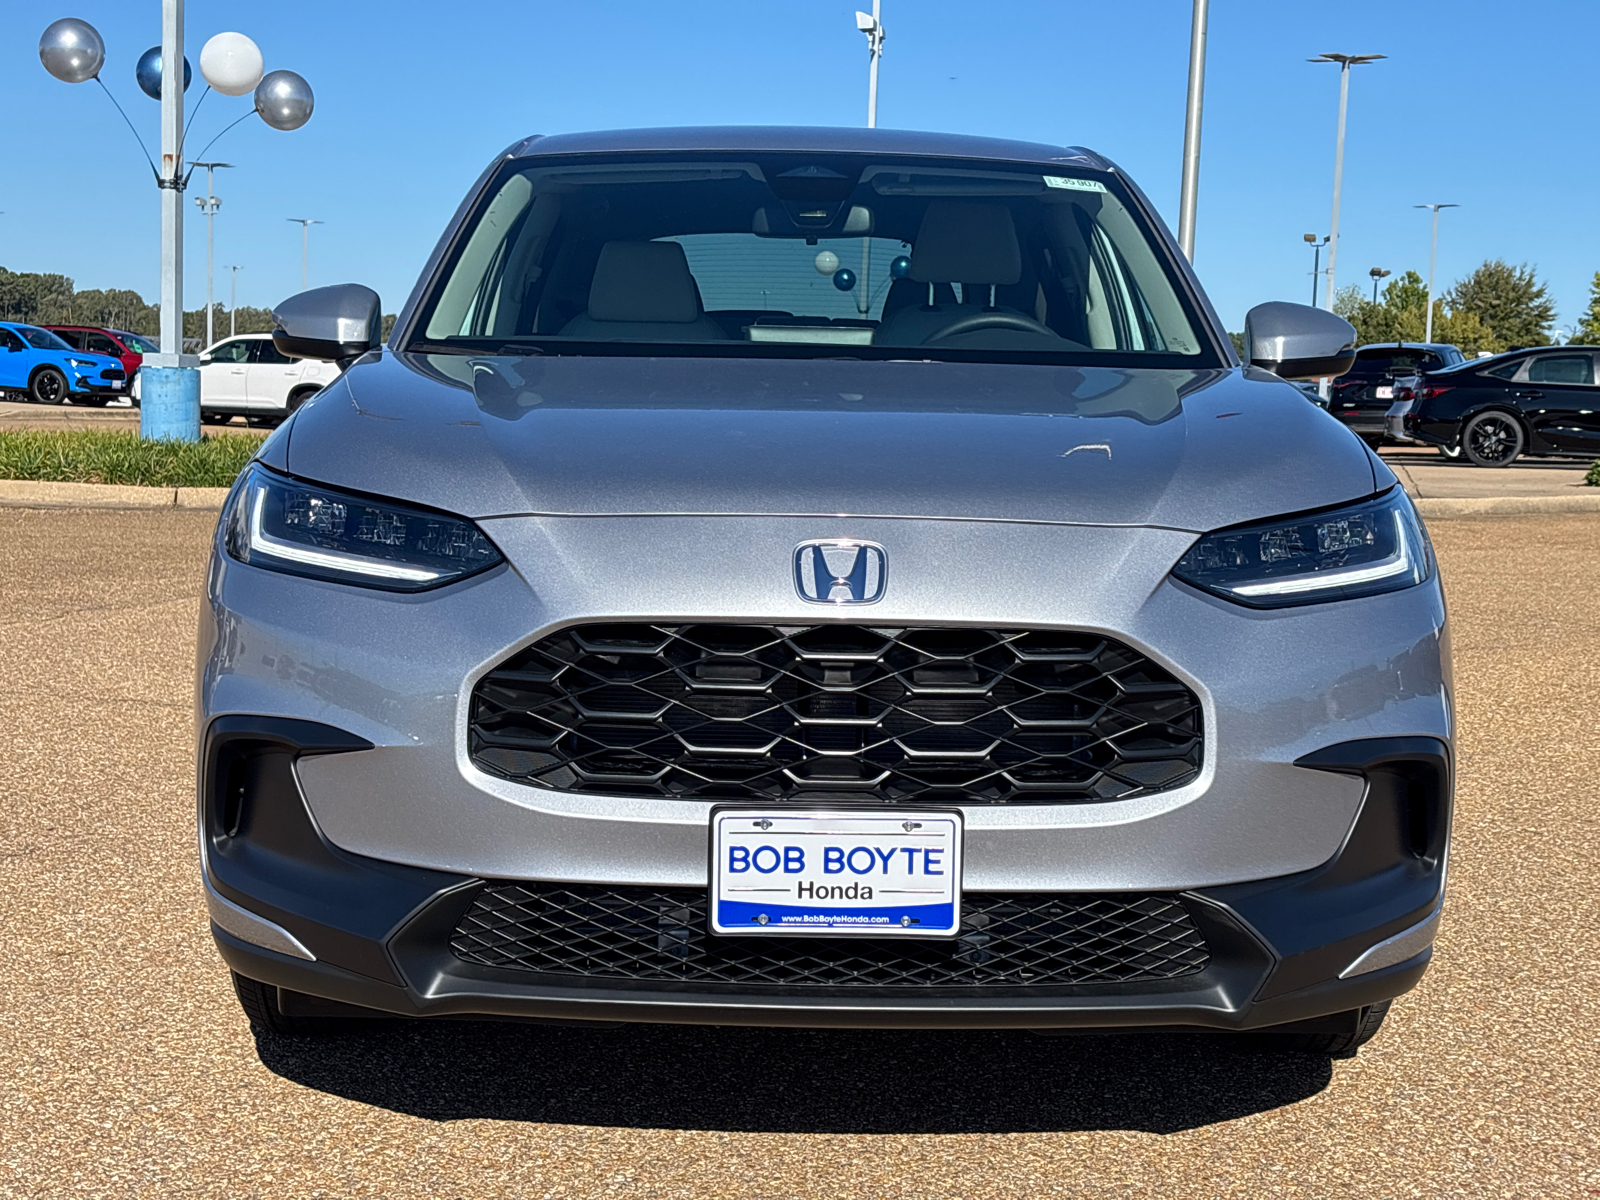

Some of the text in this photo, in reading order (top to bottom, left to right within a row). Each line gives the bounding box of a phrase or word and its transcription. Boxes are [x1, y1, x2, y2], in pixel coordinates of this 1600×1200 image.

[729, 845, 945, 876] BOB BOYTE
[797, 881, 873, 900] Honda
[781, 914, 890, 925] www.BobBoyteHonda.com
